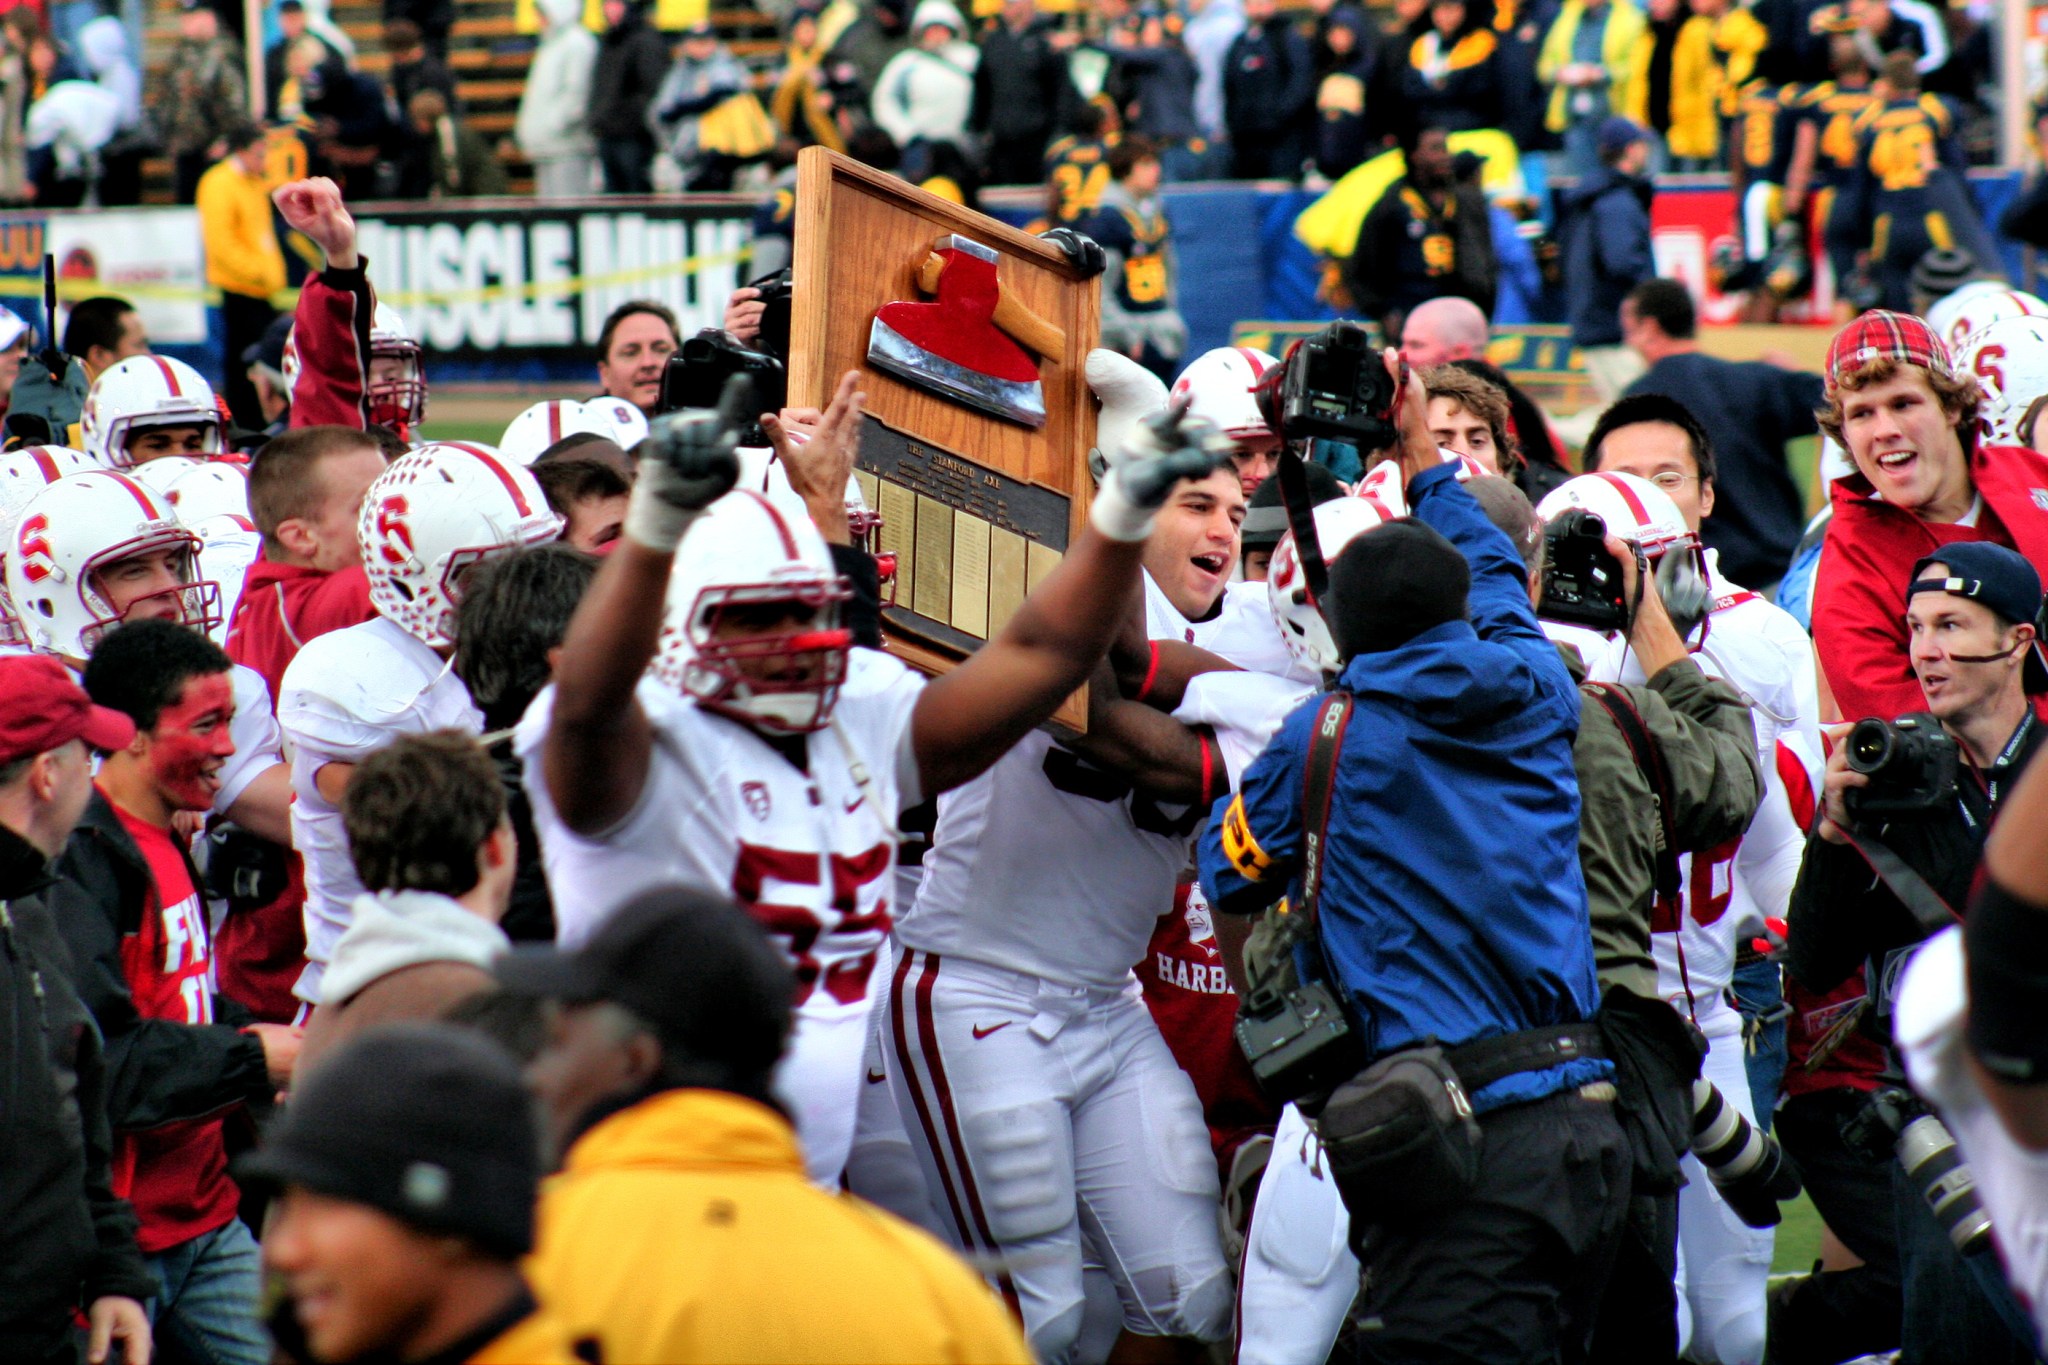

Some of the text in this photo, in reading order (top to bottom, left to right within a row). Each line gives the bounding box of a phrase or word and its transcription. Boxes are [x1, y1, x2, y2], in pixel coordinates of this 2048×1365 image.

[906, 443, 925, 458] THE
[932, 453, 976, 478] STANFORD
[983, 474, 1001, 490] AXE
[1322, 702, 1344, 737] EOS
[1305, 832, 1318, 898] DIGITAL
[1157, 952, 1236, 994] HARB
